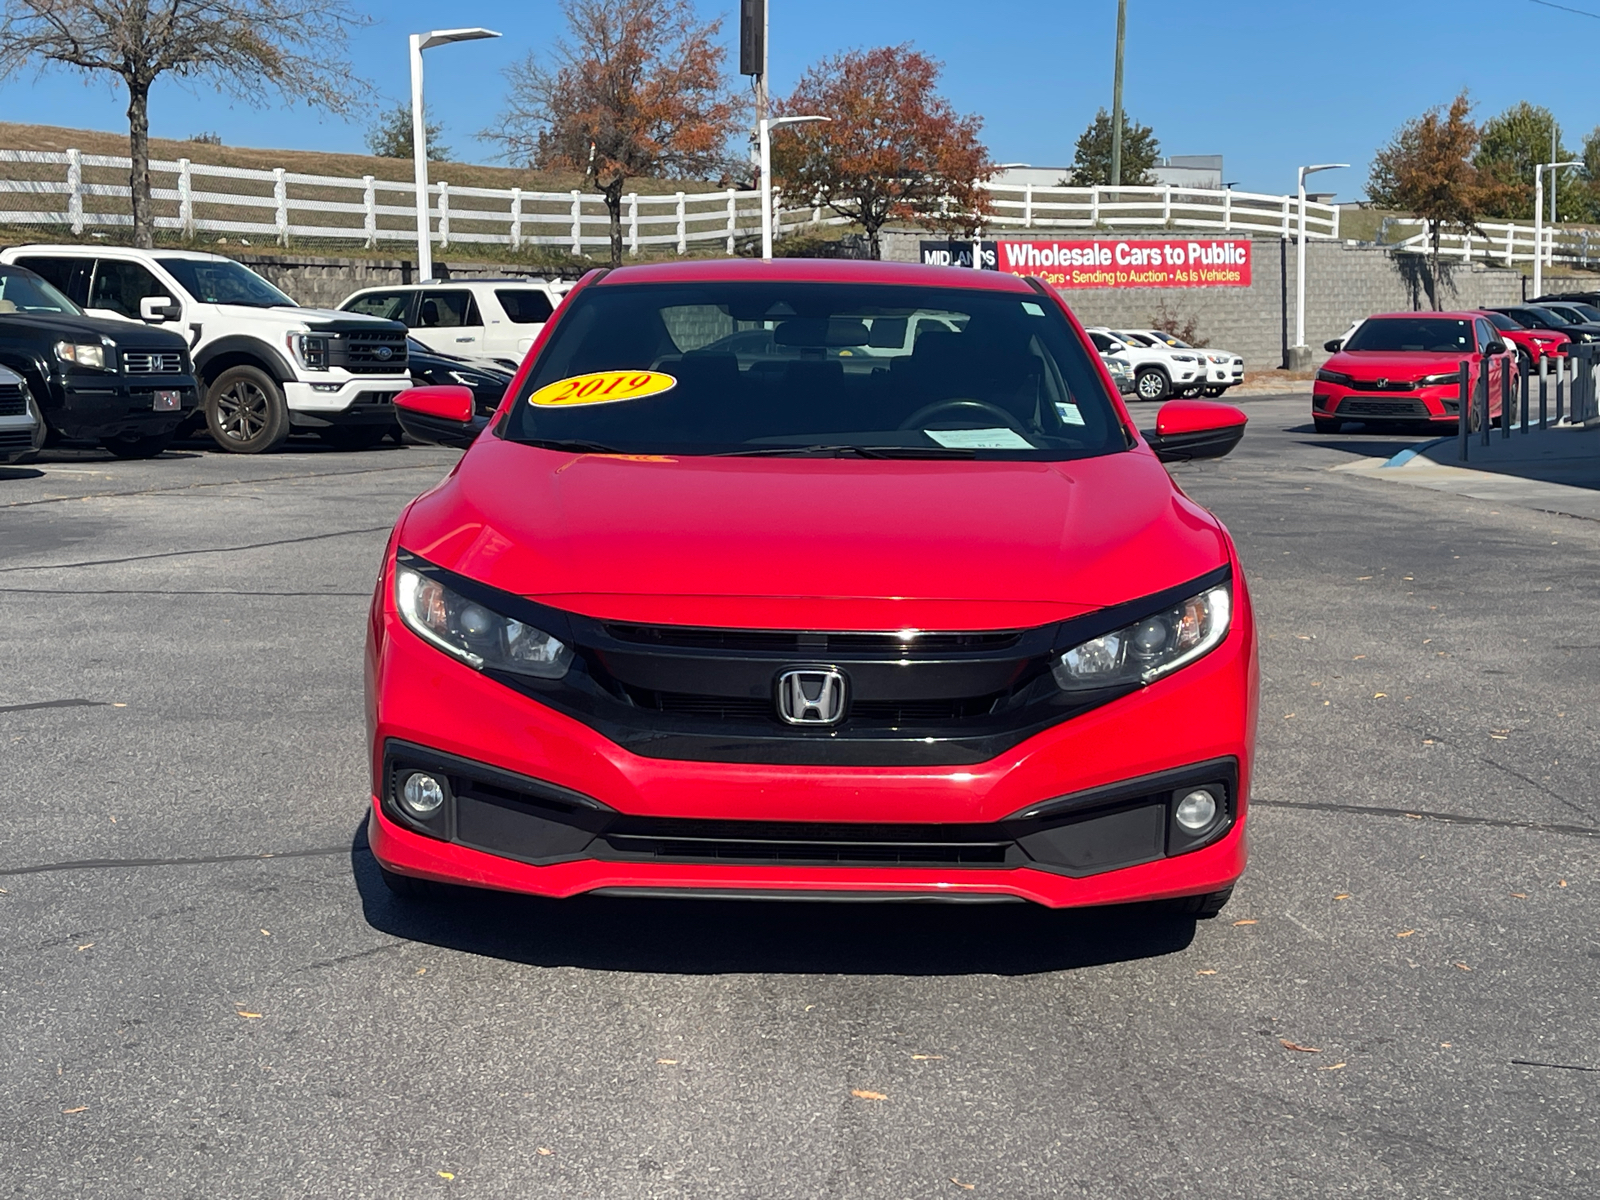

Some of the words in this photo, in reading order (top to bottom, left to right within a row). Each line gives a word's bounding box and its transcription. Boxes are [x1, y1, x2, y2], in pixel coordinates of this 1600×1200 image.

[1004, 242, 1112, 266] Wholesale
[1115, 242, 1162, 266] Cars
[1164, 244, 1185, 265] to
[1187, 242, 1246, 265] Public
[1040, 270, 1065, 284] Cars
[1072, 270, 1115, 286] Sending
[1116, 270, 1128, 282] to
[1129, 270, 1168, 282] Auction
[1174, 269, 1188, 282] As
[1190, 269, 1198, 281] Is
[1199, 269, 1241, 281] Vehicles
[550, 374, 652, 403] 2019
